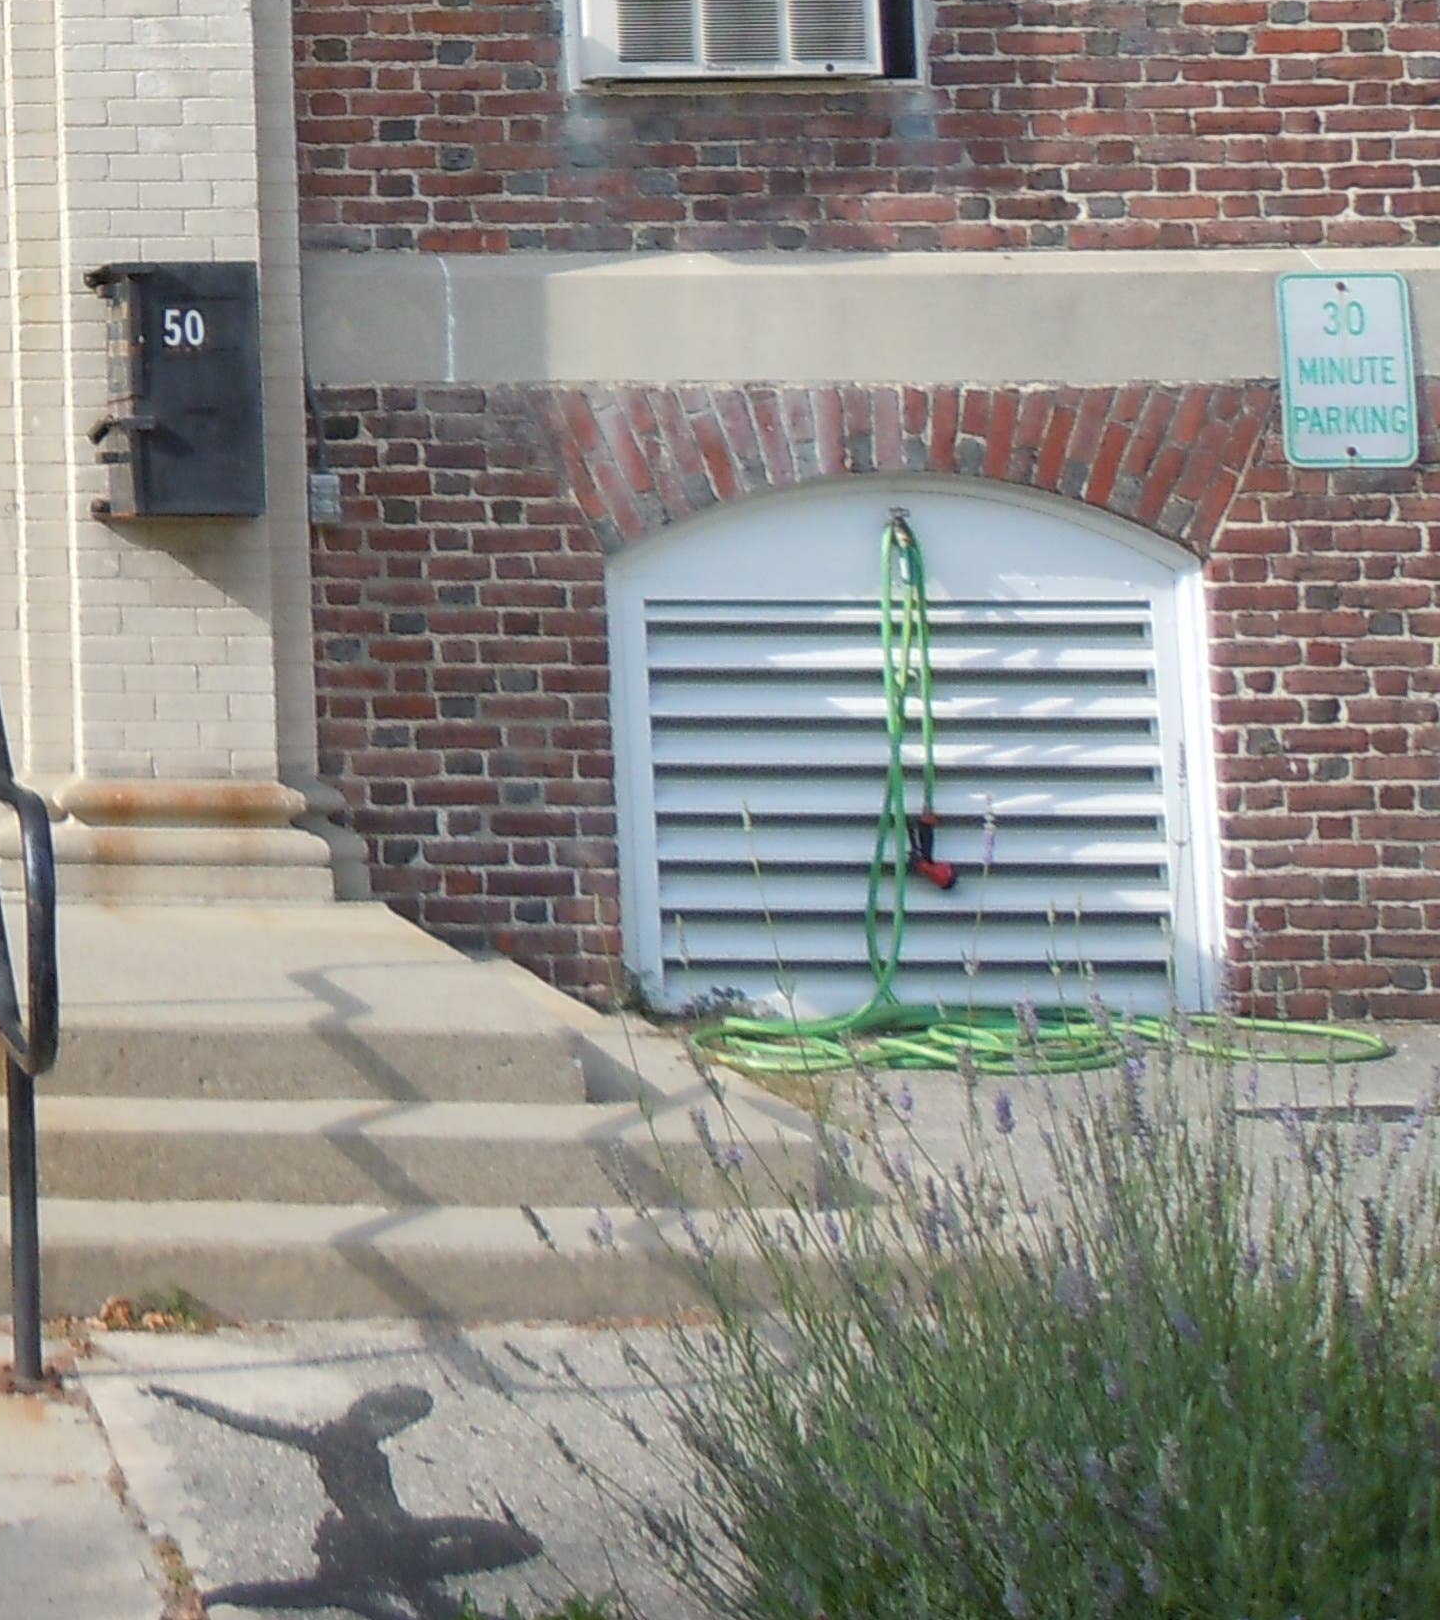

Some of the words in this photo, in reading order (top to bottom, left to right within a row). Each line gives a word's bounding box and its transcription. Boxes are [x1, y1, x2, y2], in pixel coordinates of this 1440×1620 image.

[164, 310, 205, 346] 50
[1323, 301, 1366, 336] 30
[1298, 356, 1397, 385] MINUTE
[1294, 405, 1408, 435] PARKING
